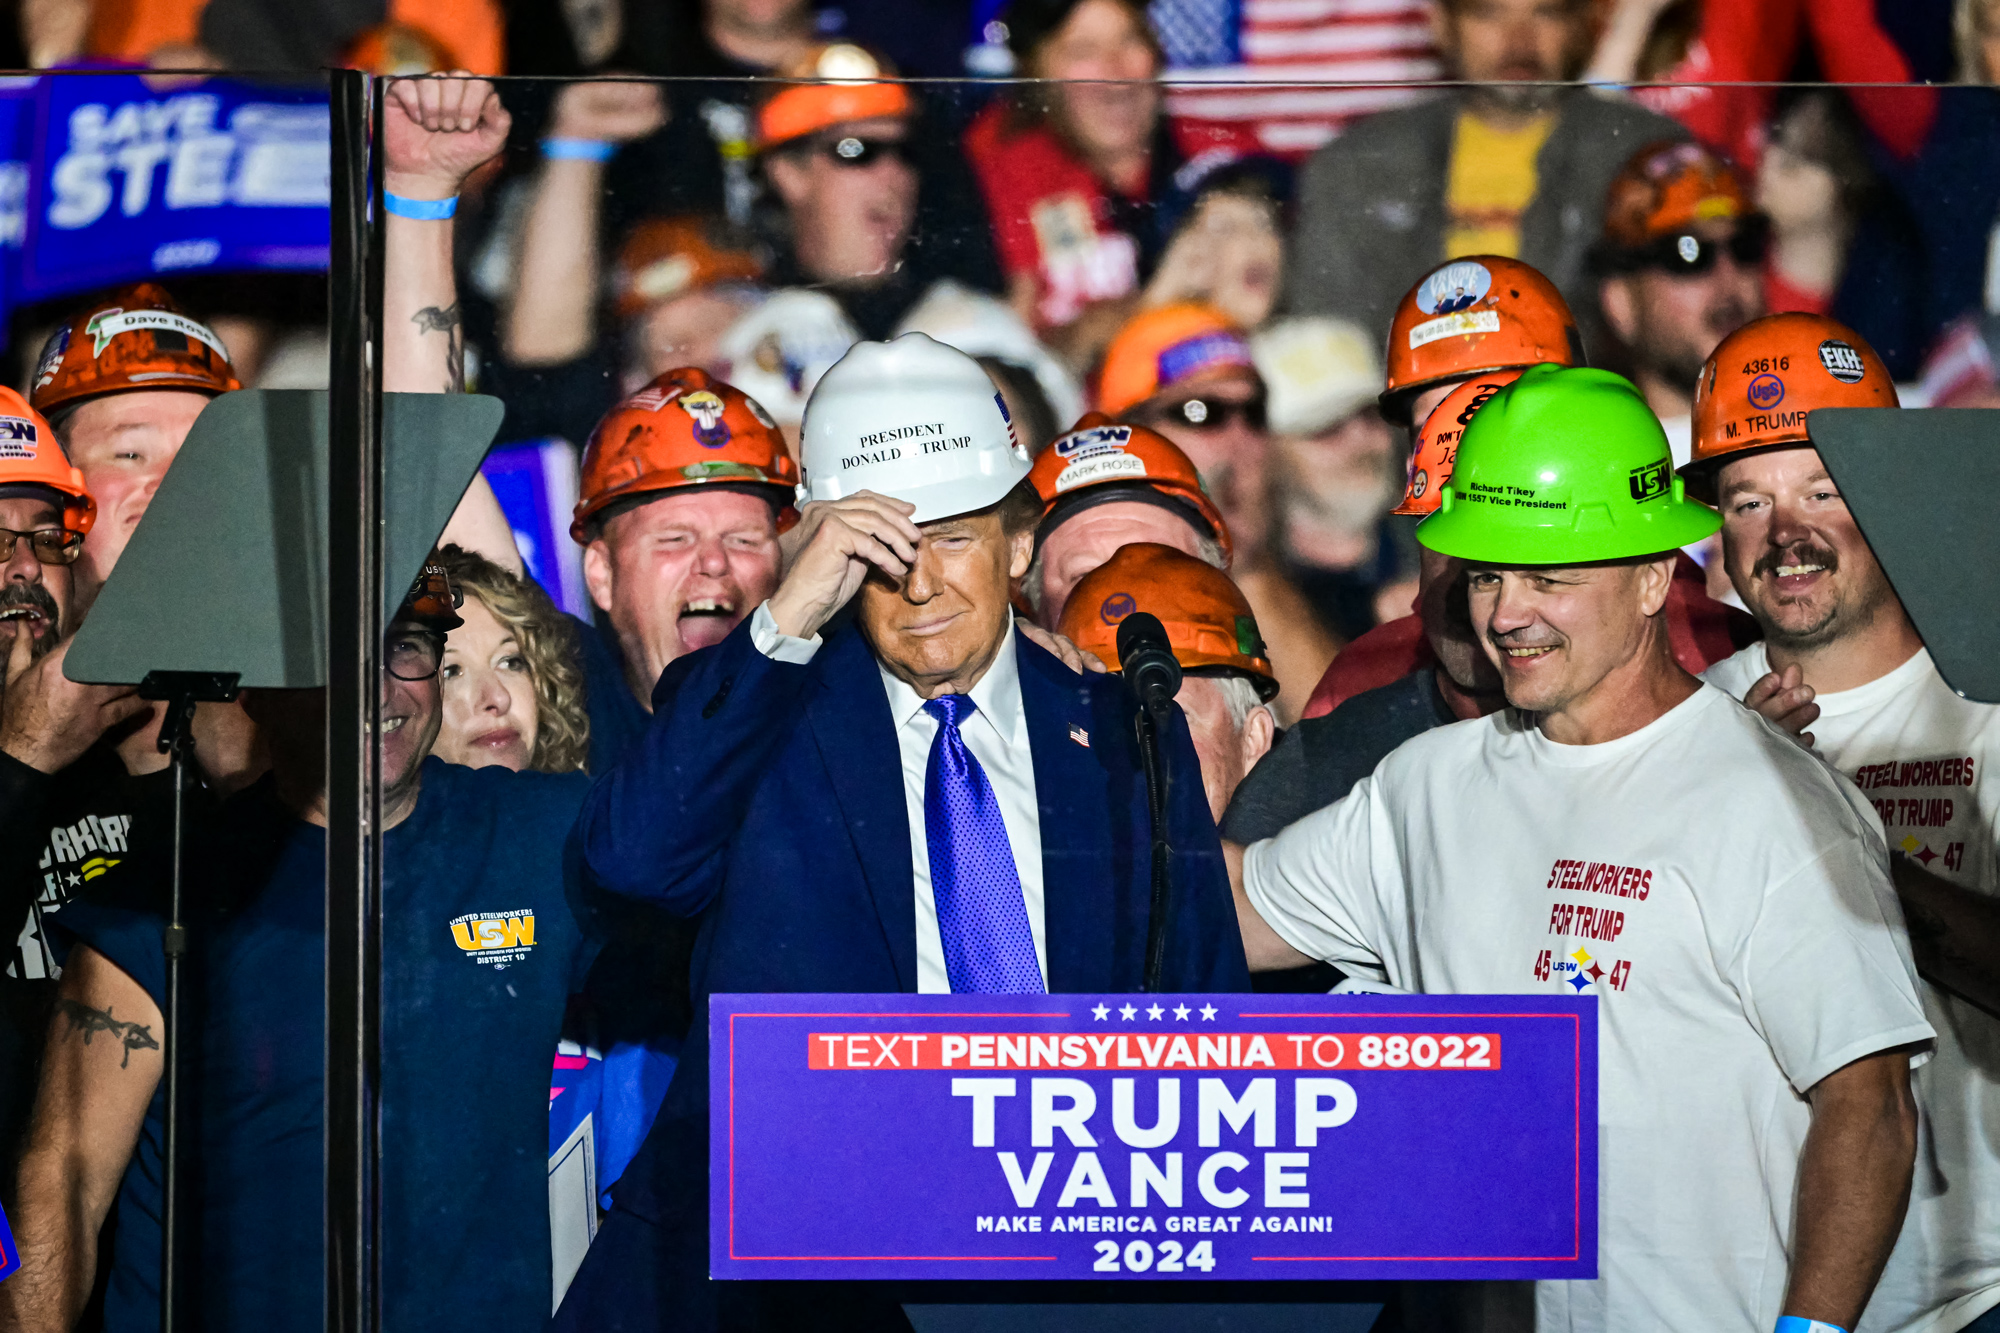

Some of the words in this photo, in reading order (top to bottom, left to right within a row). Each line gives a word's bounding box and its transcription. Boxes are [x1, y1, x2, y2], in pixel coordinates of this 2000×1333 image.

[124, 316, 168, 325] Dave
[174, 319, 211, 341] Rose
[1742, 356, 1790, 375] 43616
[860, 423, 945, 448] PRESIDENT
[1436, 429, 1461, 446] DON'T
[1726, 422, 1741, 439] M.
[1746, 411, 1808, 433] TRUMP
[841, 448, 901, 470] DONALD
[920, 436, 971, 454] TRUMP
[1058, 428, 1130, 453] USW
[1061, 464, 1098, 485] MARK
[1102, 460, 1141, 471] ROSE
[1629, 462, 1670, 500] USW
[1468, 494, 1487, 503] 1557
[1489, 496, 1511, 506] Vice
[1514, 498, 1567, 510] President
[1470, 482, 1503, 494] Richard
[1507, 486, 1535, 498] Tikey
[1855, 757, 1974, 789] STEELWORKERS
[1871, 798, 1894, 826] OR
[1897, 798, 1953, 827] TRUMP
[1944, 842, 1965, 872] 47
[1547, 859, 1653, 901] STEELWORKERS
[449, 913, 479, 926] UNITED
[480, 909, 533, 920] STEELWORKERS
[1549, 904, 1574, 935] FOR
[1574, 905, 1625, 942] TRUMP
[450, 916, 535, 951] USW
[477, 955, 513, 965] DISTRICT
[515, 953, 526, 961] 10
[1534, 950, 1552, 982] 45
[1553, 961, 1577, 972] USW
[1609, 960, 1632, 991] 47
[818, 1035, 927, 1067] TEXT
[941, 1035, 1275, 1068] PENNSYLVANIA
[1287, 1035, 1344, 1068] TO
[1358, 1035, 1491, 1068] 88022
[951, 1077, 1358, 1149] TRUMP
[996, 1151, 1310, 1209] VANCE
[976, 1216, 1043, 1232] MAKE
[1050, 1216, 1158, 1232] AMERICA
[1165, 1216, 1242, 1232] GREAT
[1249, 1216, 1333, 1232] AGAIN!
[1093, 1240, 1216, 1272] 2024
